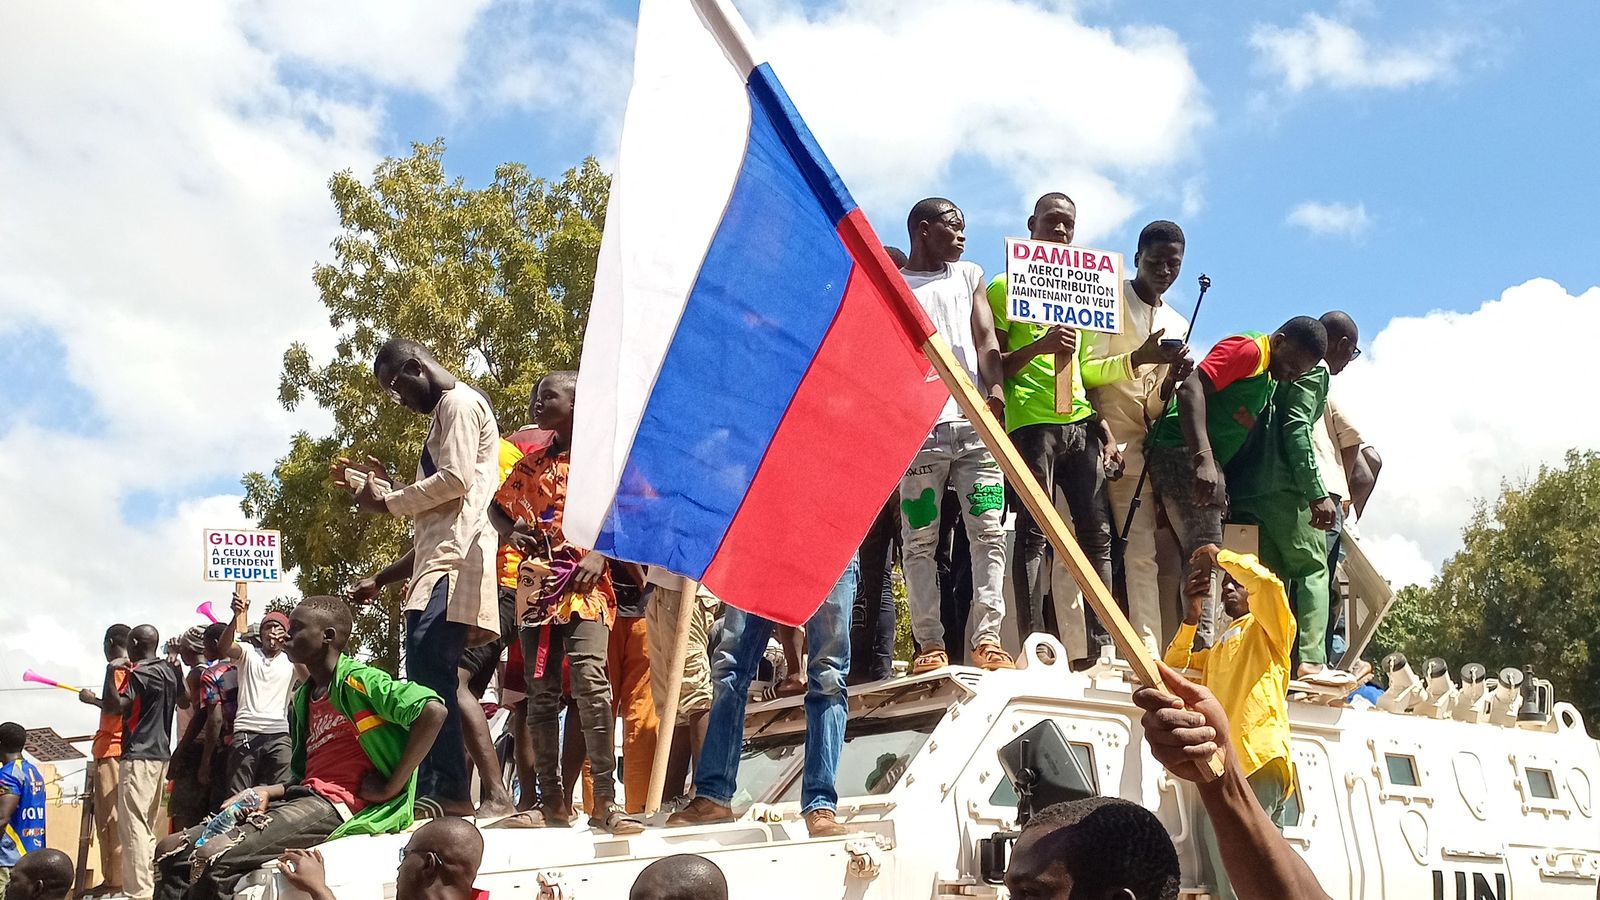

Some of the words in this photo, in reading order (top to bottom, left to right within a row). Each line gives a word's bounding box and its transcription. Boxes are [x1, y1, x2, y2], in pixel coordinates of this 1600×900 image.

[1013, 243, 1115, 273] DAMIBA
[1028, 264, 1063, 278] MERCI
[1067, 269, 1100, 283] POUR
[1012, 273, 1026, 284] TA
[1030, 276, 1114, 297] CONTRIBUTION
[1012, 286, 1072, 303] MAINTENANT
[1075, 295, 1090, 306] ON
[1092, 297, 1115, 309] VEUT
[1012, 298, 1036, 319] IB.
[1042, 302, 1115, 330] TRAORE
[209, 532, 276, 547] GLOIRE
[212, 557, 275, 567] DEFENDENT
[223, 548, 250, 557] CEUX
[253, 549, 274, 558] QUI
[209, 570, 219, 578] LE
[224, 567, 278, 580] PEUPLE
[1432, 870, 1506, 900] UN
